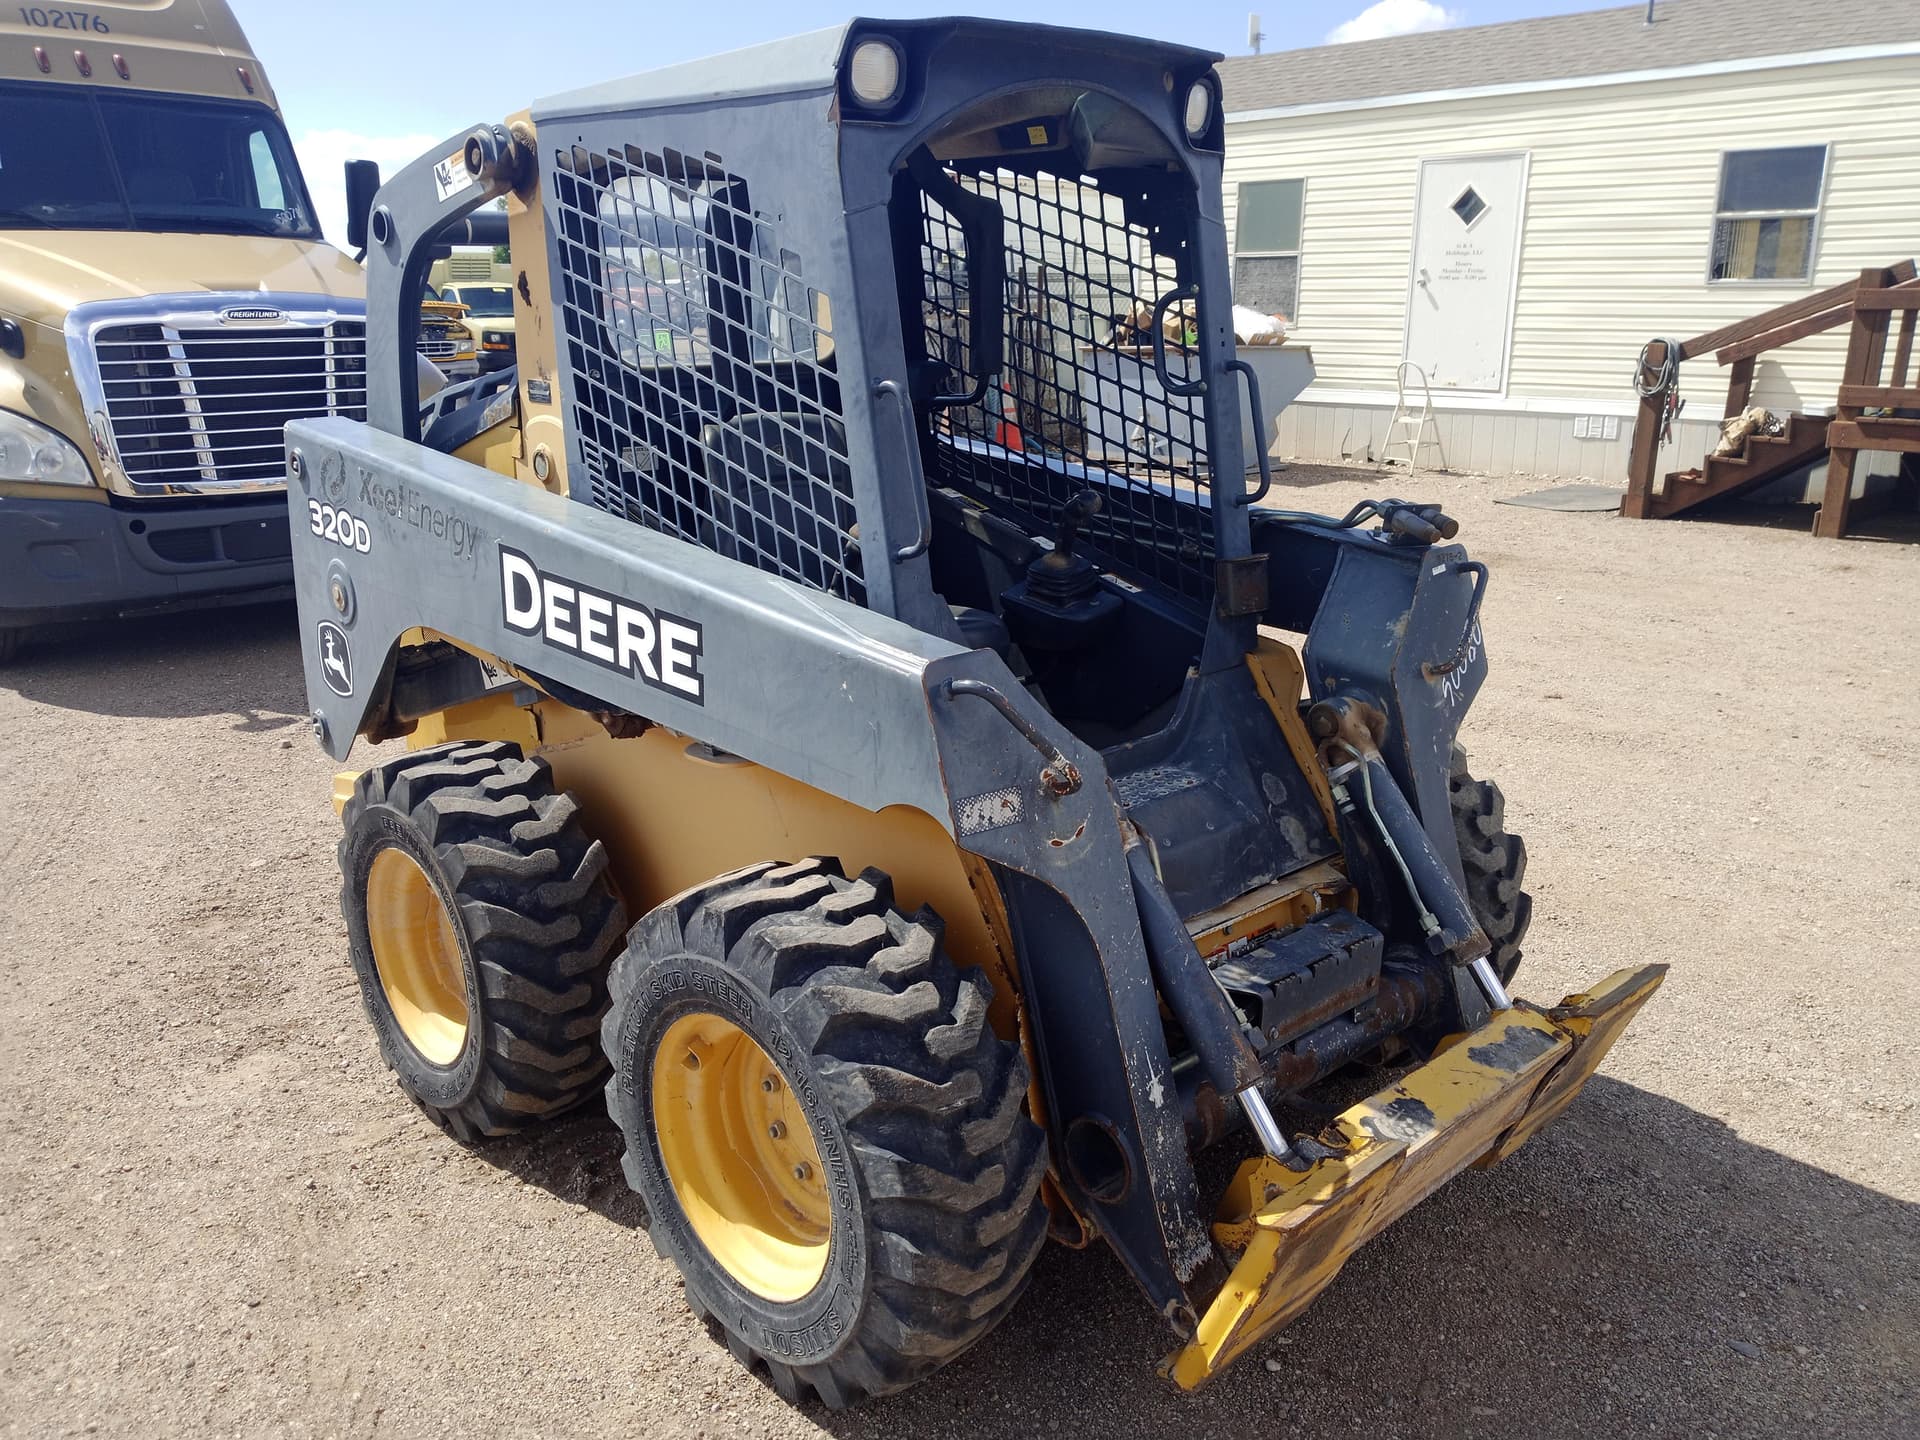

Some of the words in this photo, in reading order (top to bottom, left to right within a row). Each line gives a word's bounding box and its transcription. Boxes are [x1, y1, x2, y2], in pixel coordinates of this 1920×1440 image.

[18, 7, 111, 34] 102176
[306, 497, 373, 555] 320D
[501, 548, 702, 699] DEERE
[620, 990, 654, 1097] PREMIUM
[649, 969, 688, 1001] SKID
[690, 969, 754, 1022] STEER
